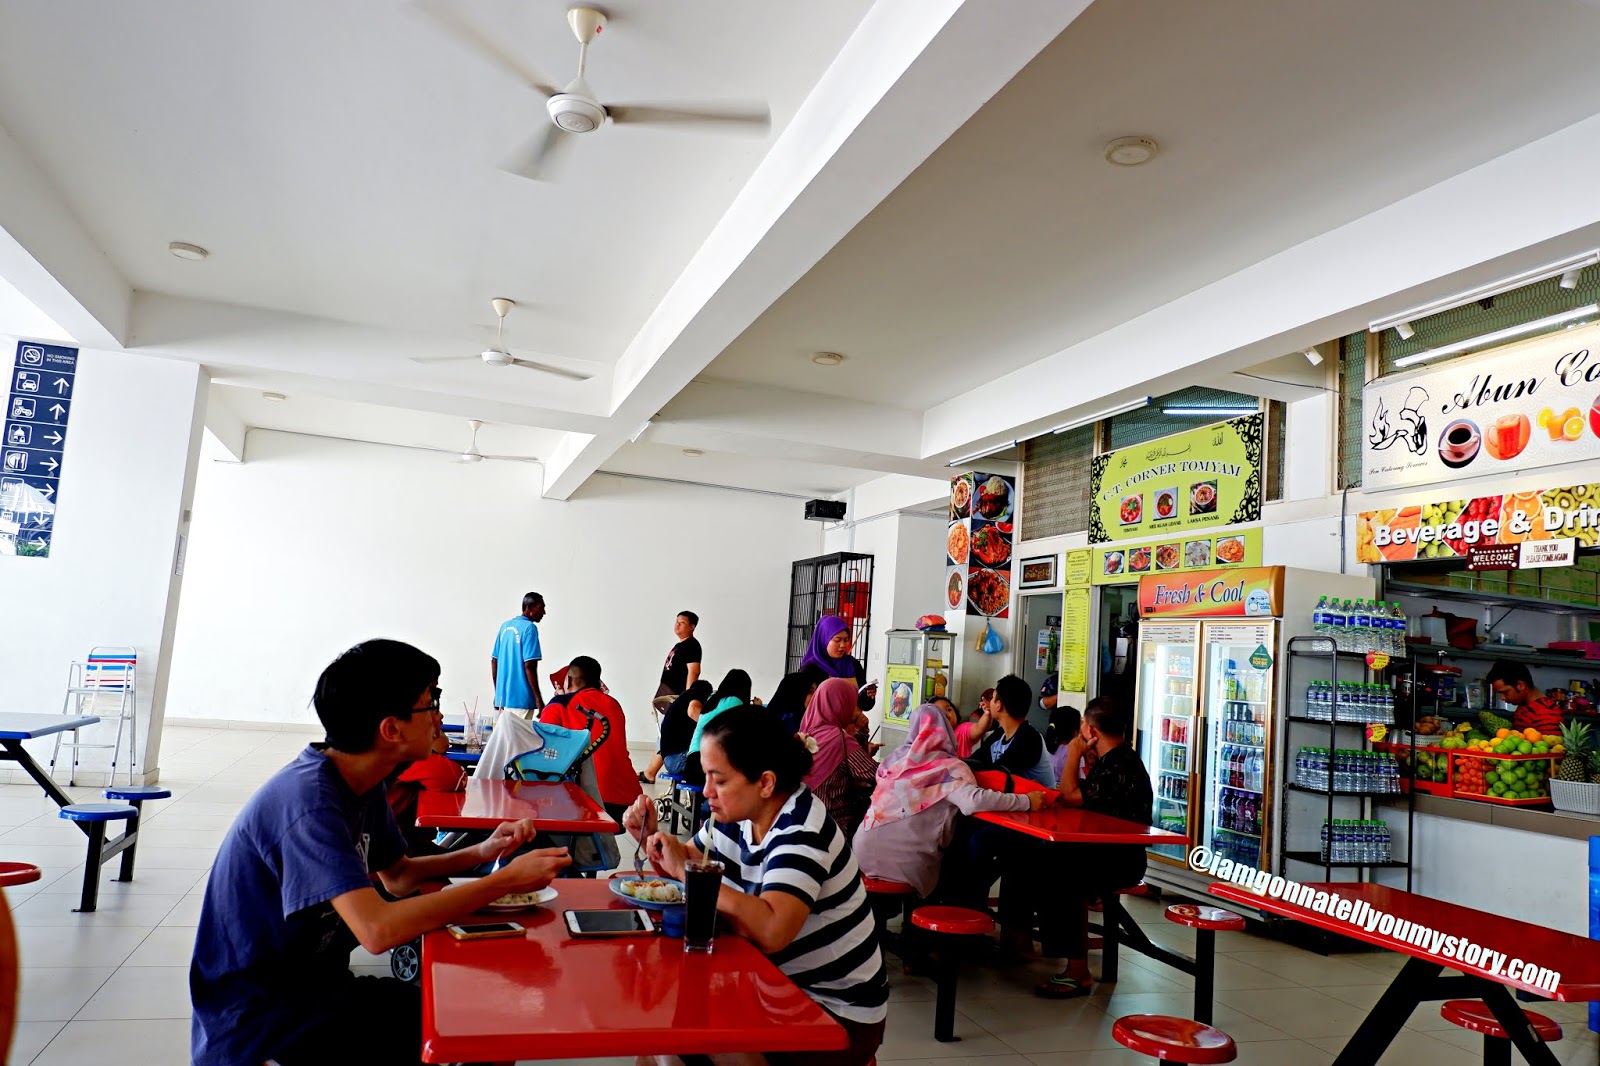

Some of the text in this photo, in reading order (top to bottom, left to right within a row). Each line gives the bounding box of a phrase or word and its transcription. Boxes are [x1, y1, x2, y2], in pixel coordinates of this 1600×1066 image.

[1124, 463, 1177, 488] CORNER
[1179, 460, 1242, 478] TOMYAM
[1375, 519, 1499, 546] Beverage
[1509, 510, 1532, 534] &
[1534, 544, 1559, 553] THANK YOU
[1554, 553, 1568, 562] AGAIN
[1472, 553, 1515, 563] WELCOME
[1154, 579, 1245, 605] Fresh & Cool
